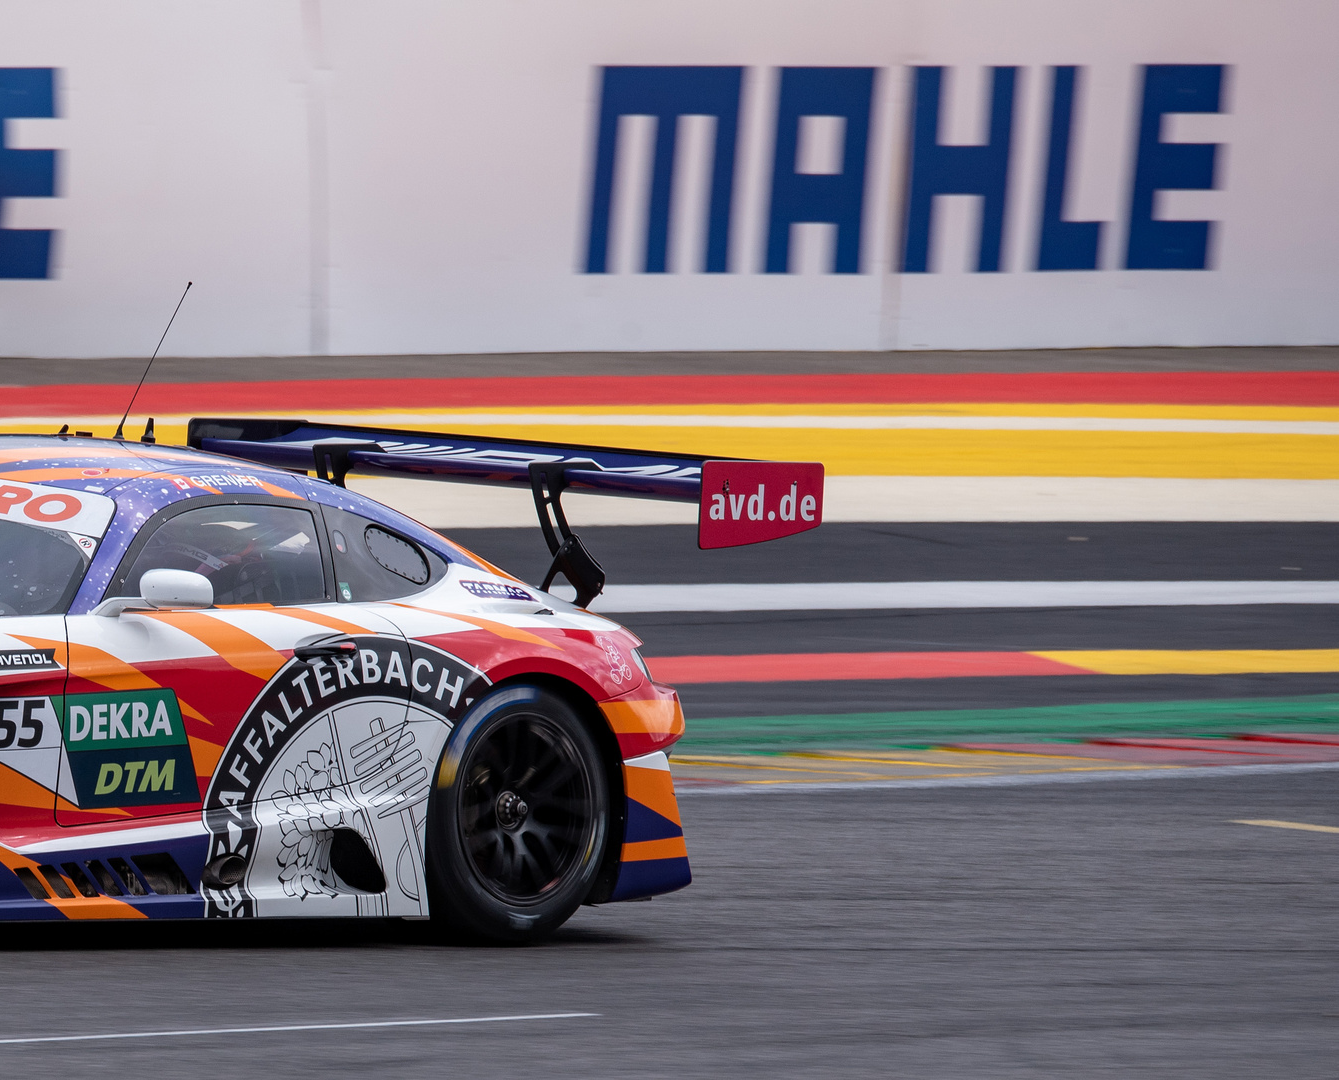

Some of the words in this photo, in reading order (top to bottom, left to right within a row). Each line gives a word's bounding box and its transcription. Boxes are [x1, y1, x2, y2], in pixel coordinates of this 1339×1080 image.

[573, 64, 1236, 275] MAHLE
[190, 475, 264, 487] GRENIER
[709, 484, 816, 521] avd.de
[69, 700, 173, 742] DEKRA
[218, 649, 465, 819] AFFALTERBACH
[94, 759, 176, 795] DTM
